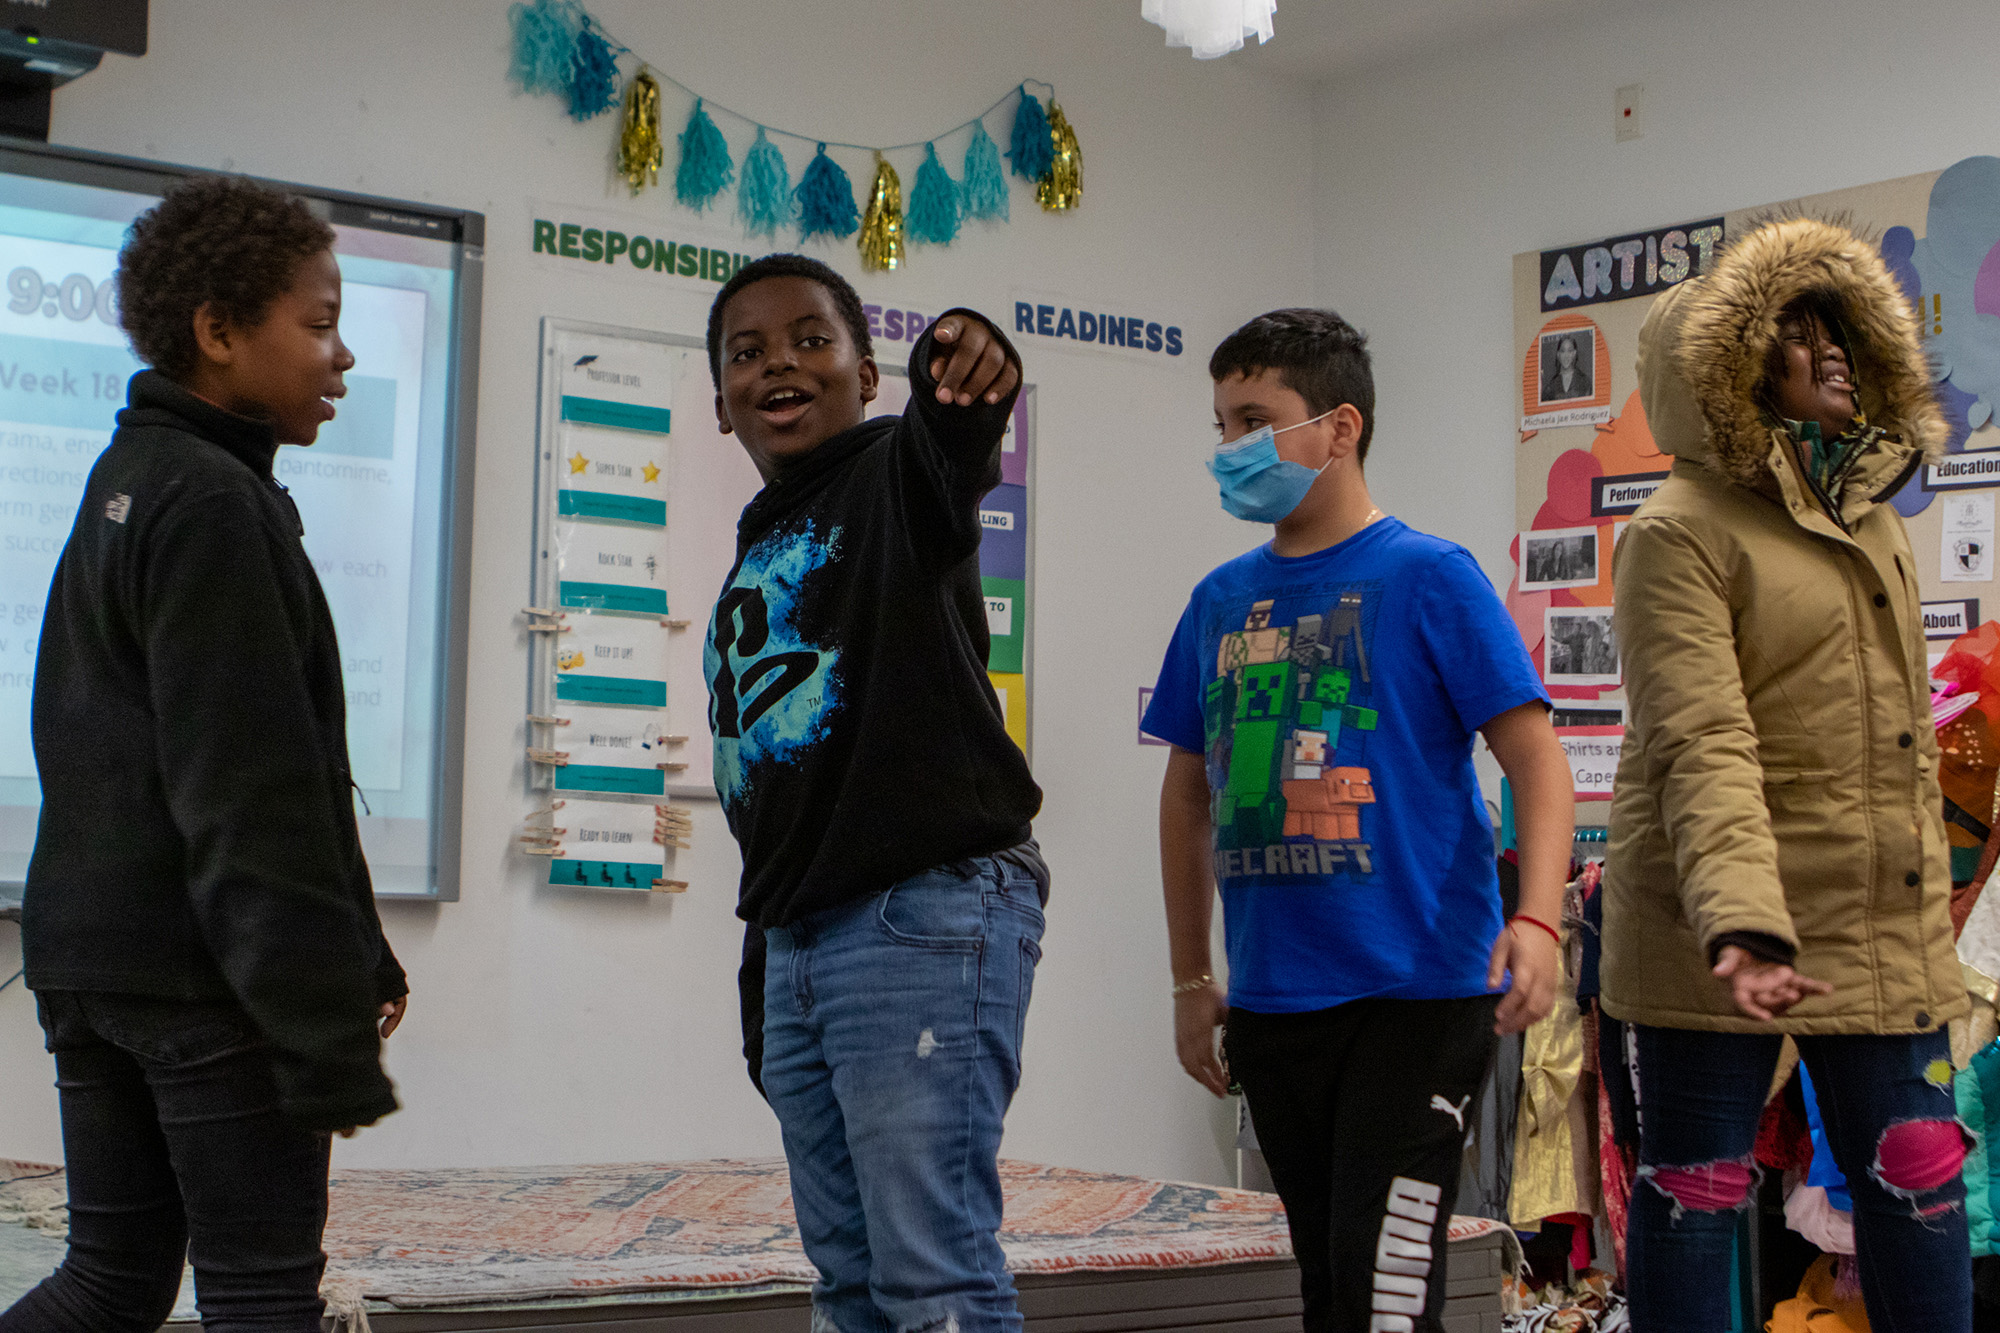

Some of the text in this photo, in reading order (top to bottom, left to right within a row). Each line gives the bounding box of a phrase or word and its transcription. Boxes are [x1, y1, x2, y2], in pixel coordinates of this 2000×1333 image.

[533, 218, 751, 283] RESPONSIBI
[1544, 225, 1723, 304] ARTIST
[862, 304, 938, 343] ESP
[1014, 301, 1184, 357] READINESS
[92, 371, 121, 401] 18
[1570, 410, 1608, 422] Rodriguez
[279, 458, 393, 486] pantomime,
[1610, 486, 1658, 502] Perform
[981, 514, 1008, 526] LING
[342, 559, 388, 578] each
[990, 602, 1005, 612] TO
[1923, 613, 1961, 628] About
[346, 657, 383, 673] and
[807, 696, 823, 709] TM
[1576, 769, 1616, 787] Cape
[1218, 843, 1373, 878] ECRAFT
